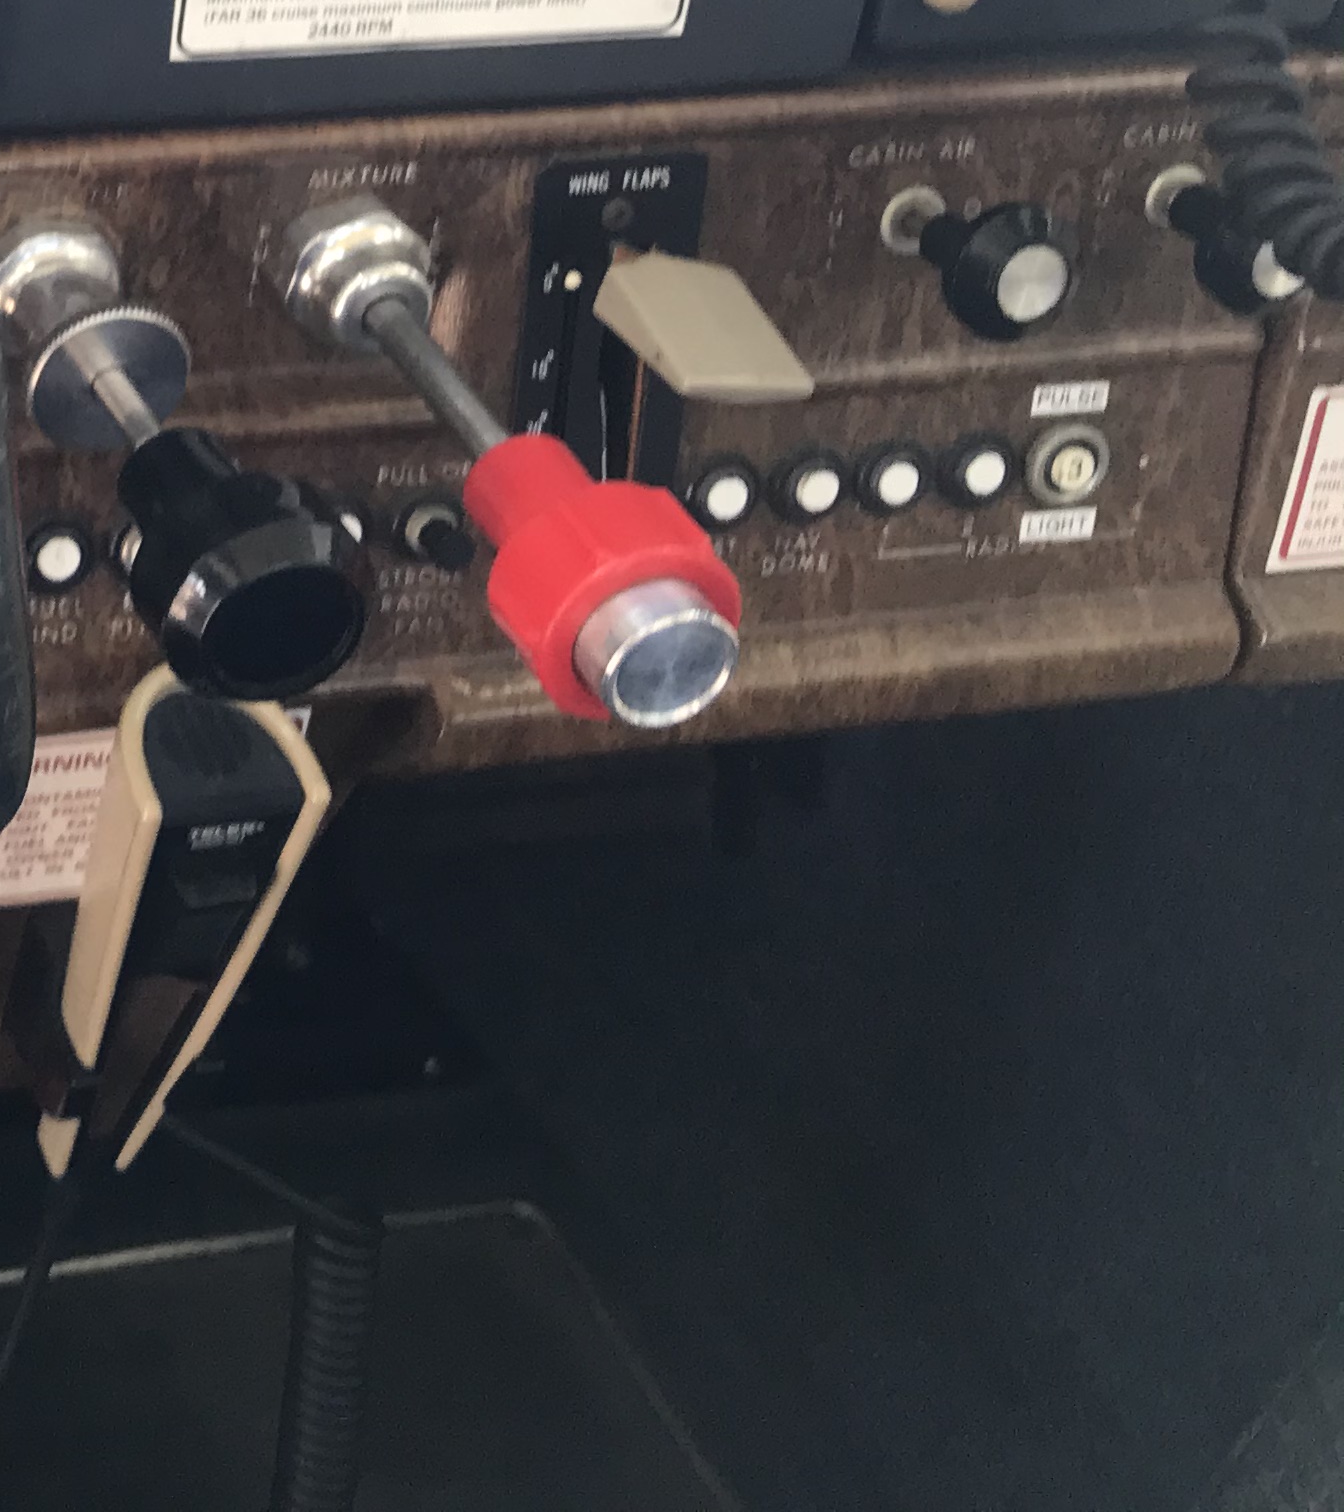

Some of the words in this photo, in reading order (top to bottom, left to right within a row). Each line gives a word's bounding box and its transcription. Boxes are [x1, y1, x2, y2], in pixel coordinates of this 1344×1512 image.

[569, 169, 610, 198] WING
[622, 165, 671, 192] FLAPS
[1026, 515, 1090, 536] LIGHT
